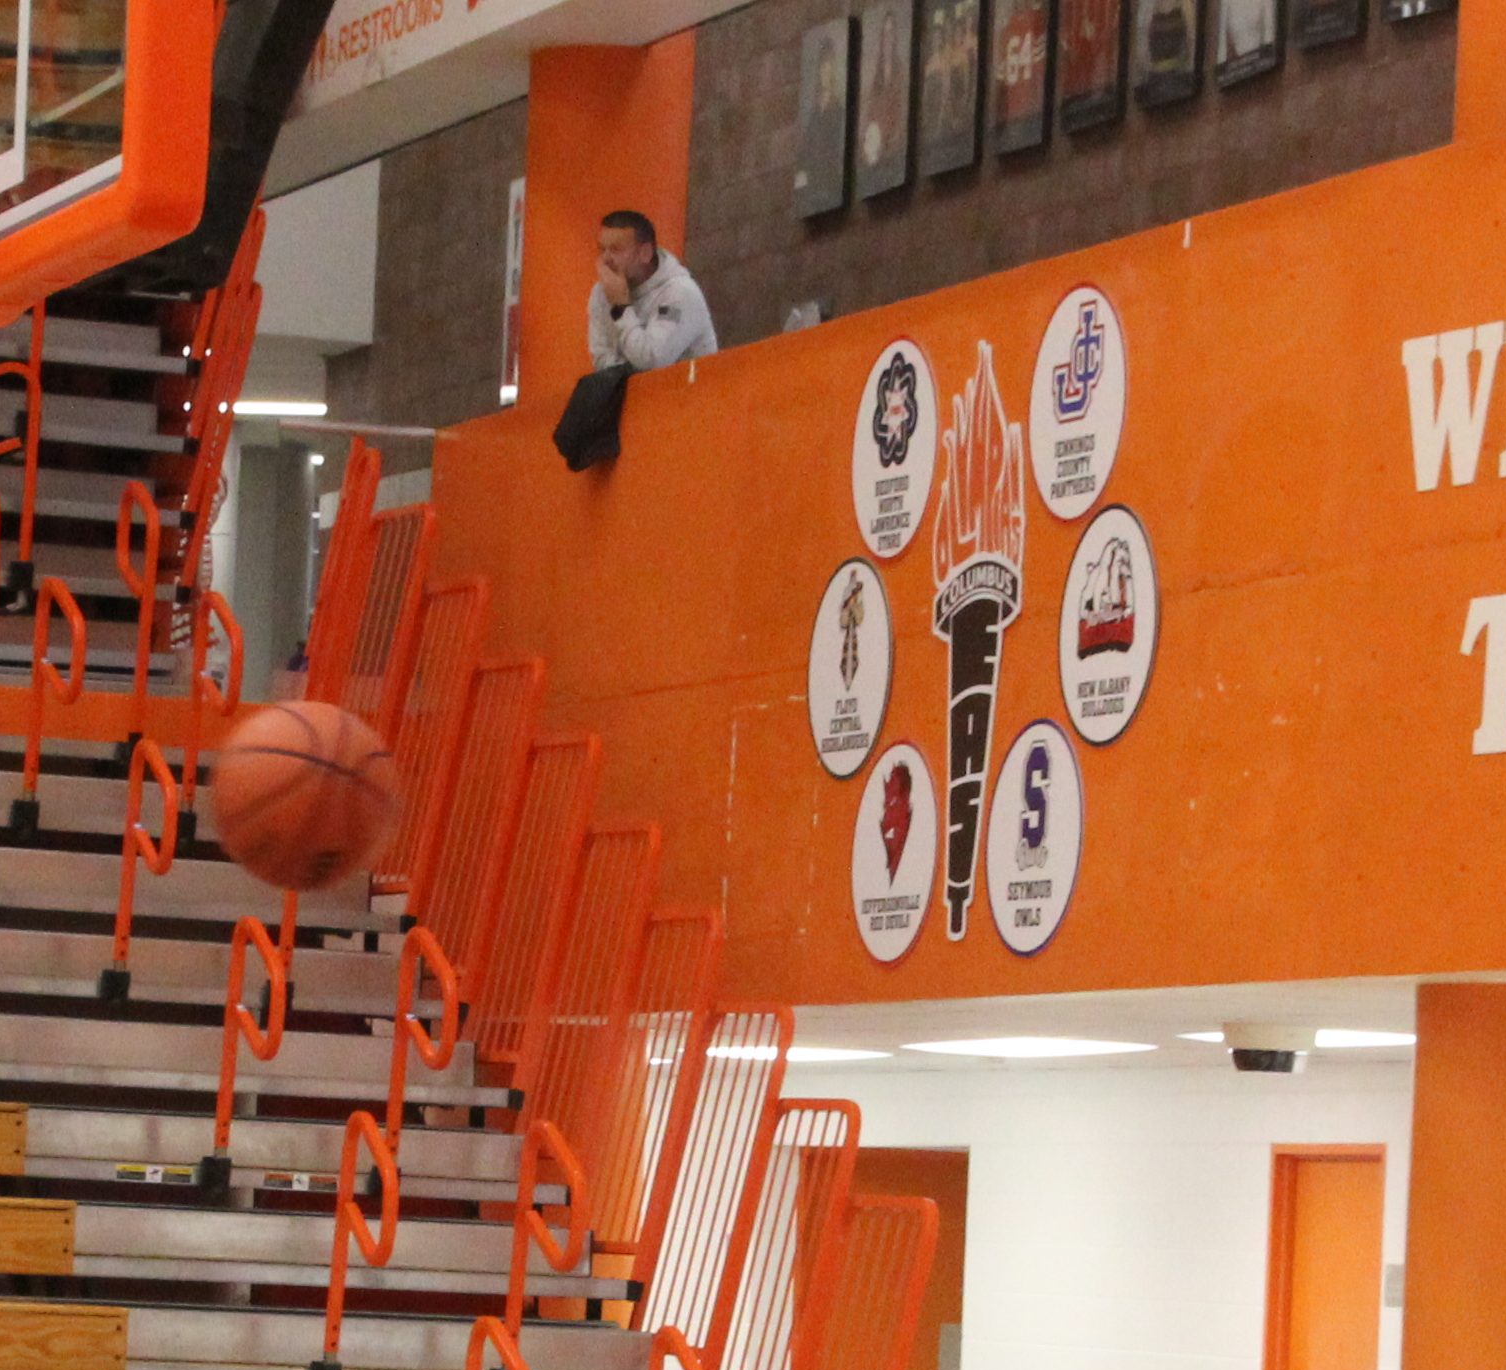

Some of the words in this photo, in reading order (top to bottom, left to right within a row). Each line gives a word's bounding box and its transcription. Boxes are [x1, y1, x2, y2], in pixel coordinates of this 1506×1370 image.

[337, 0, 444, 62] RESTROOMS
[1057, 456, 1090, 478] COUNTY
[1050, 475, 1096, 500] PANTHERS
[943, 563, 1014, 614] COLUMBUS
[1078, 681, 1096, 698] NEW
[1098, 676, 1131, 695] ALBANY
[947, 592, 1005, 940] EAST
[1008, 879, 1052, 900] SEYMOUR
[1015, 908, 1041, 927] OWLS
